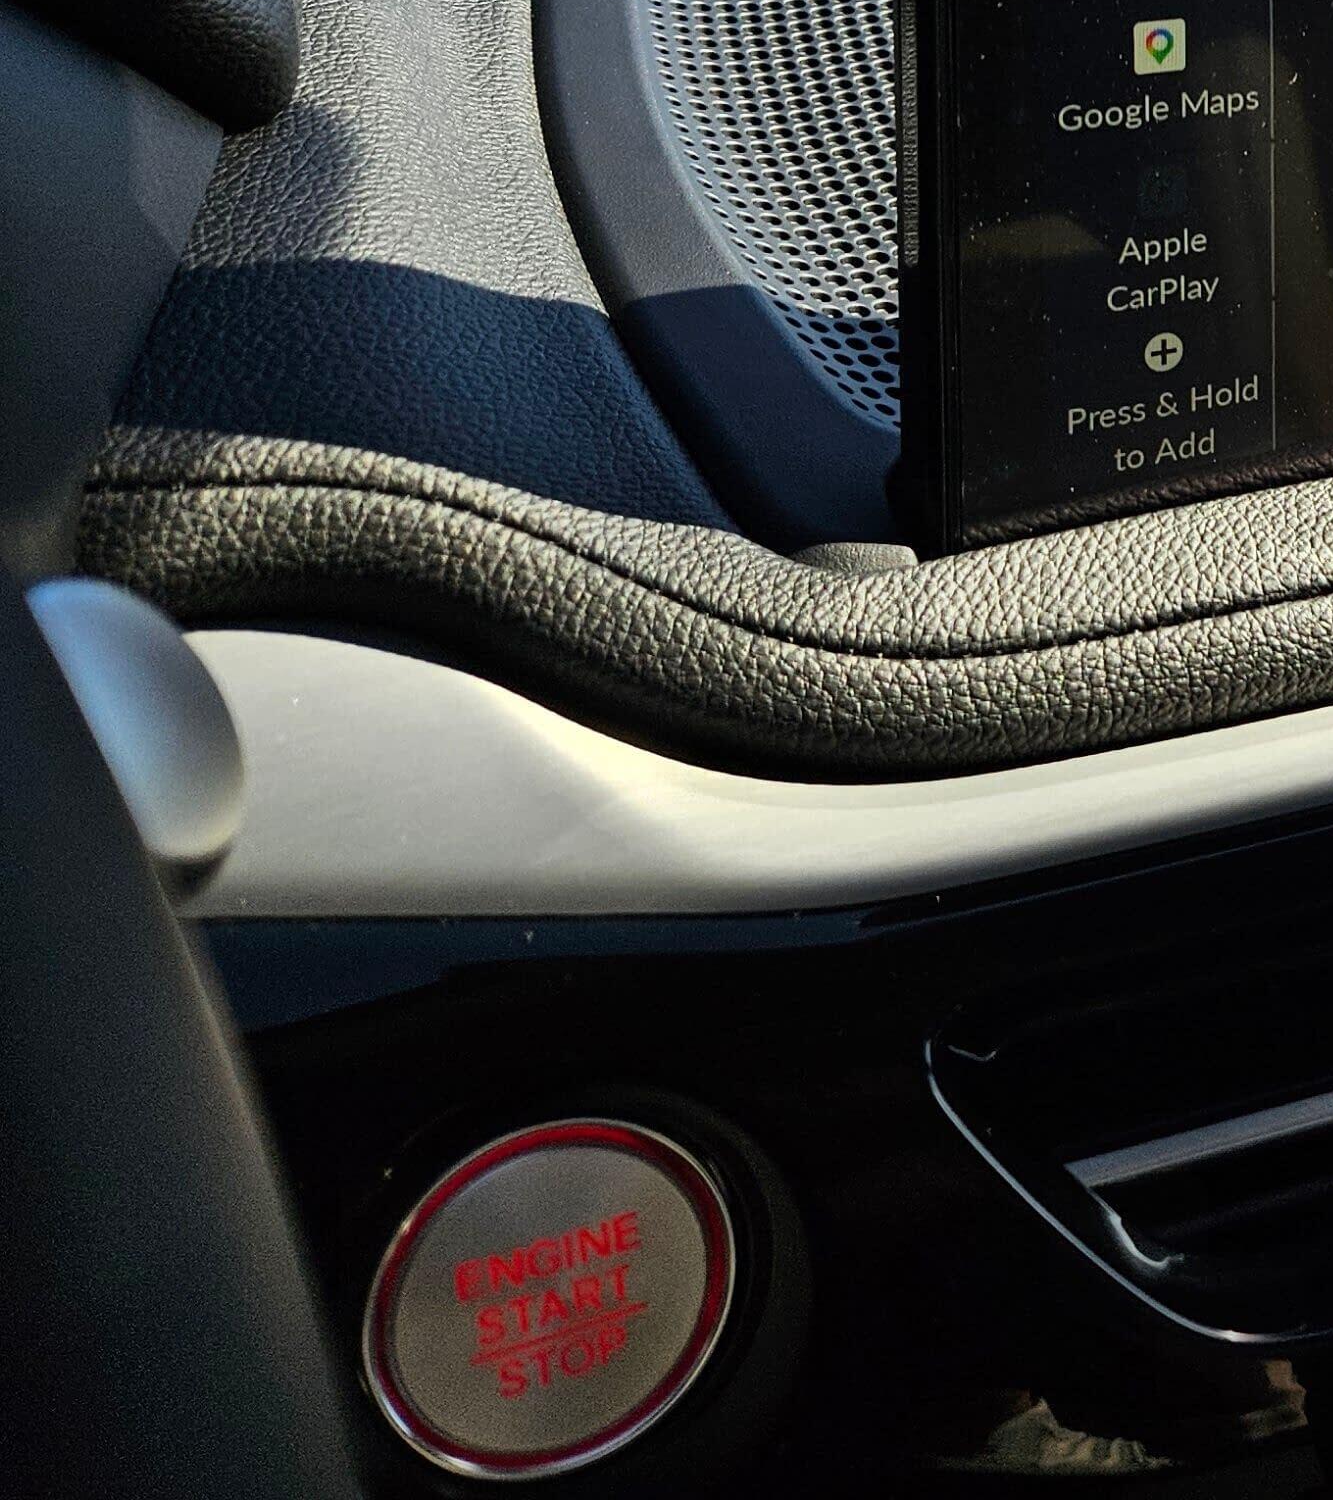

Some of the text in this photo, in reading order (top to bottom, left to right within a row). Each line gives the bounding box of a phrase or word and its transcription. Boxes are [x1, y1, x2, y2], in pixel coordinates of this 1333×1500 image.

[1057, 86, 1261, 133] Google Maps
[1118, 228, 1208, 267] Apple
[1106, 271, 1220, 314] CarPlay
[1066, 375, 1260, 436] Press & Hold
[1114, 428, 1216, 473] to Add
[453, 1211, 642, 1307] ENGINE
[475, 1264, 631, 1351] START
[497, 1324, 628, 1399] STOP
